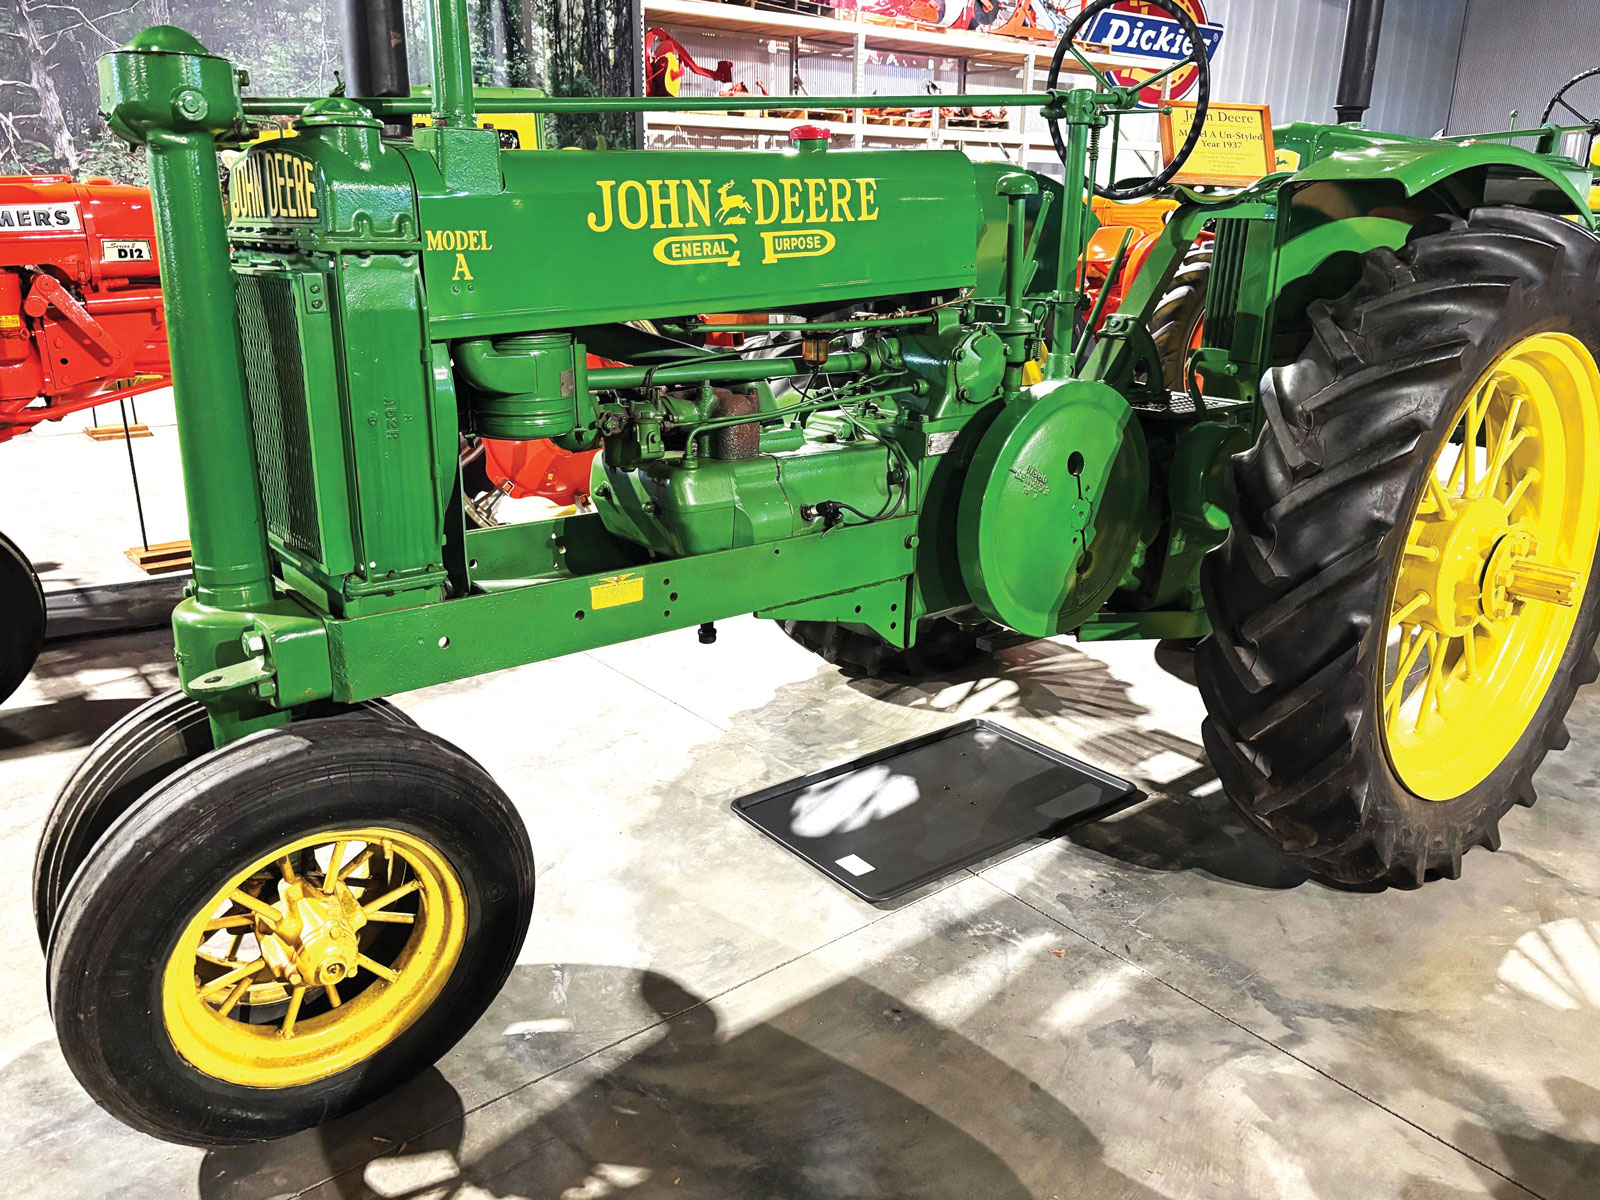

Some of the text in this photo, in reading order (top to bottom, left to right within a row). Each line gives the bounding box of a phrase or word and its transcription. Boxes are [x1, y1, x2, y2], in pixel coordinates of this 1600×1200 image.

[1184, 110, 1253, 123] Jon Deere
[1179, 129, 1207, 138] Mel
[1220, 131, 1263, 141] Un-Styled
[1202, 140, 1242, 149] Year 1937
[232, 153, 318, 217] JOHN DEERE
[587, 178, 879, 233] JOHN DEERE
[425, 230, 493, 251] MODEL
[653, 229, 836, 267] GENERAL PURPOSE
[452, 253, 474, 280] A
